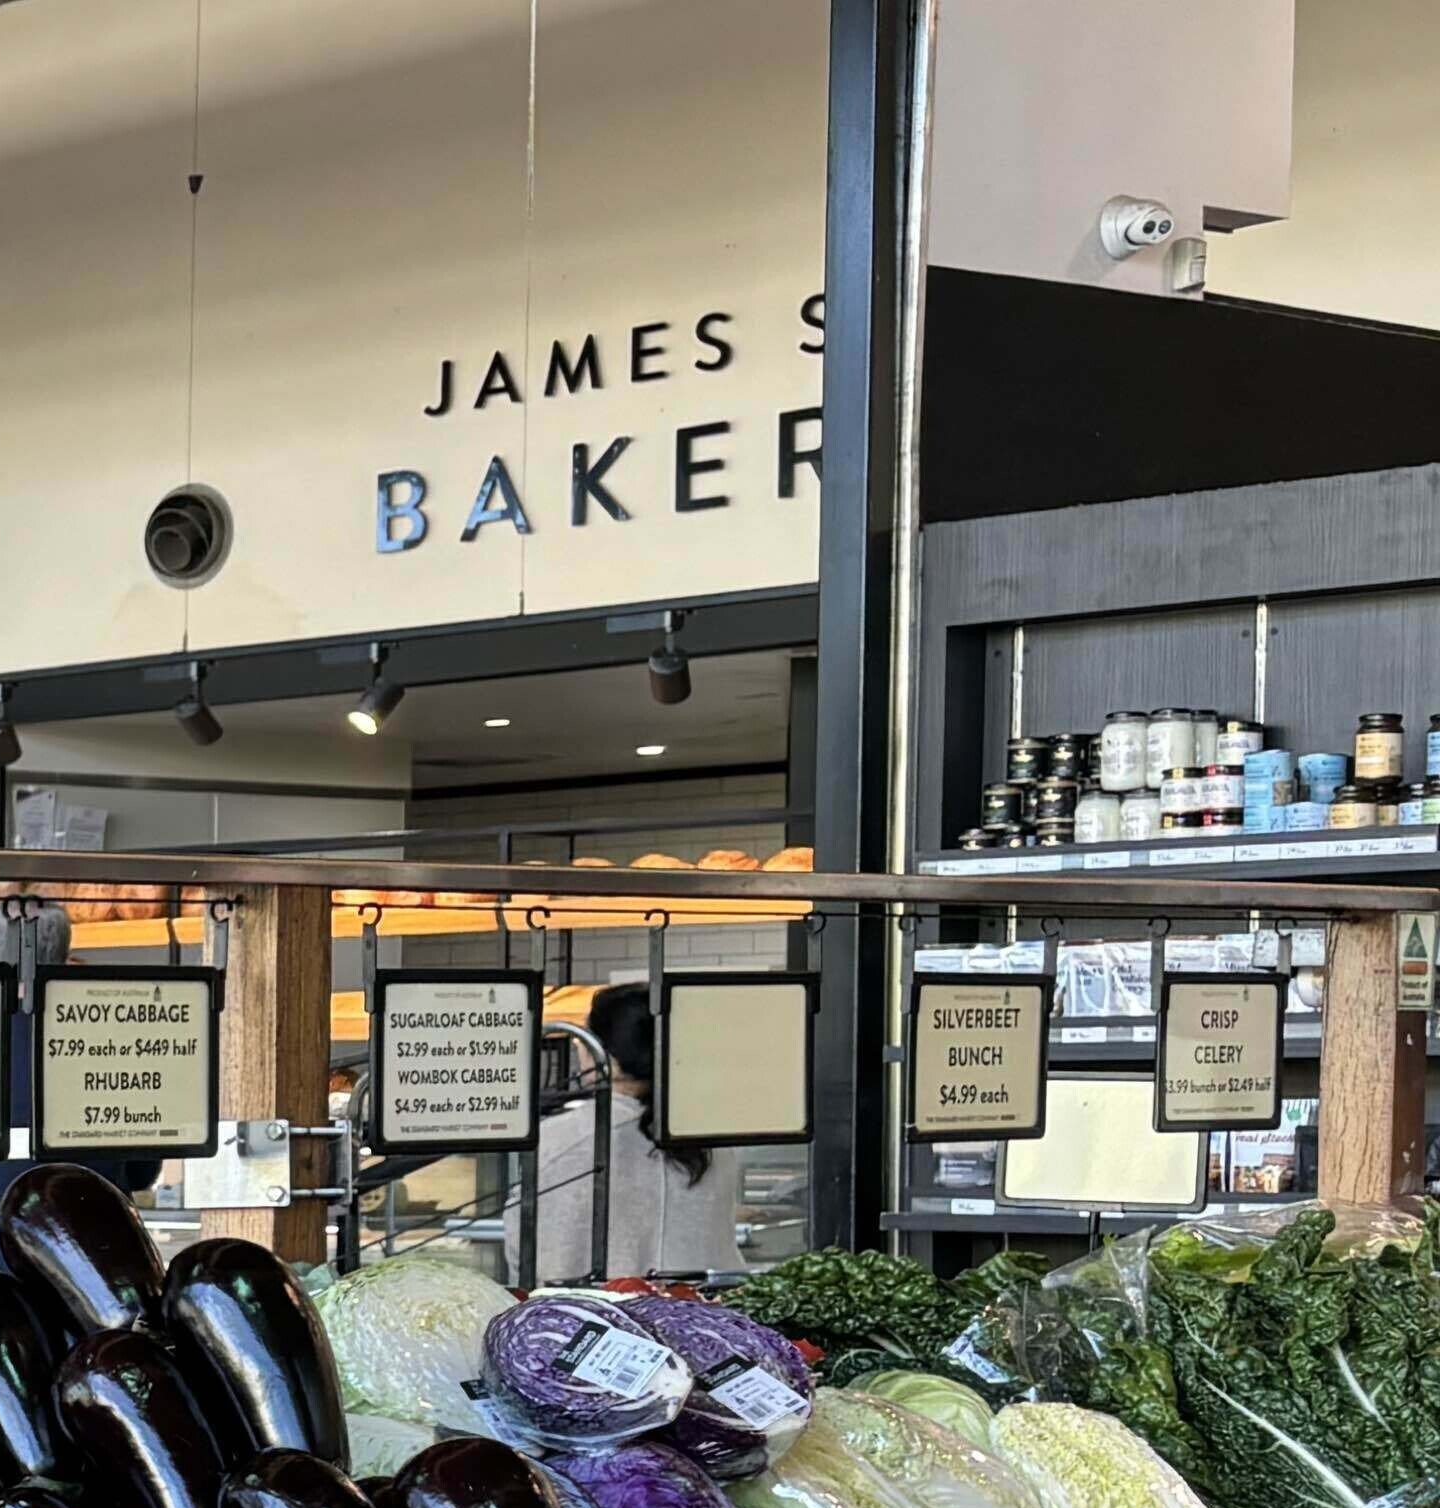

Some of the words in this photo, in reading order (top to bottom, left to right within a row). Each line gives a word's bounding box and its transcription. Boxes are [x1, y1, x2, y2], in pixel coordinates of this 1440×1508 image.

[423, 313, 733, 416] JAMES
[376, 407, 823, 553] BAKER
[56, 1004, 111, 1023] SAVOY
[115, 1004, 190, 1022] CABBAGE
[390, 1013, 465, 1029] SUGARLOAF
[468, 1012, 523, 1027] CABBAGE
[934, 1008, 1021, 1029] SILVERBEET
[1201, 1010, 1239, 1029] CRISP
[48, 1039, 85, 1058] $7.99
[88, 1038, 116, 1057] each
[120, 1045, 132, 1056] or
[172, 1038, 197, 1056] half
[397, 1042, 429, 1057] $2.99
[432, 1041, 455, 1056] each
[457, 1047, 467, 1056] or
[469, 1041, 497, 1056] $1.99
[499, 1040, 517, 1055] half
[948, 1046, 1003, 1067] BUNCH
[1195, 1045, 1244, 1064] CELERY
[85, 1072, 162, 1090] RHUBARB
[398, 1070, 458, 1085] WOMBOK
[461, 1068, 517, 1084] CABBAGE
[940, 1084, 977, 1106] $4.99
[980, 1083, 1008, 1103] each
[395, 1099, 427, 1114] $4.99
[430, 1098, 453, 1113] each
[455, 1103, 466, 1112] or
[468, 1096, 498, 1112] $2.99
[500, 1096, 520, 1111] half
[85, 1106, 120, 1126] $7.99
[124, 1106, 162, 1123] bunch
